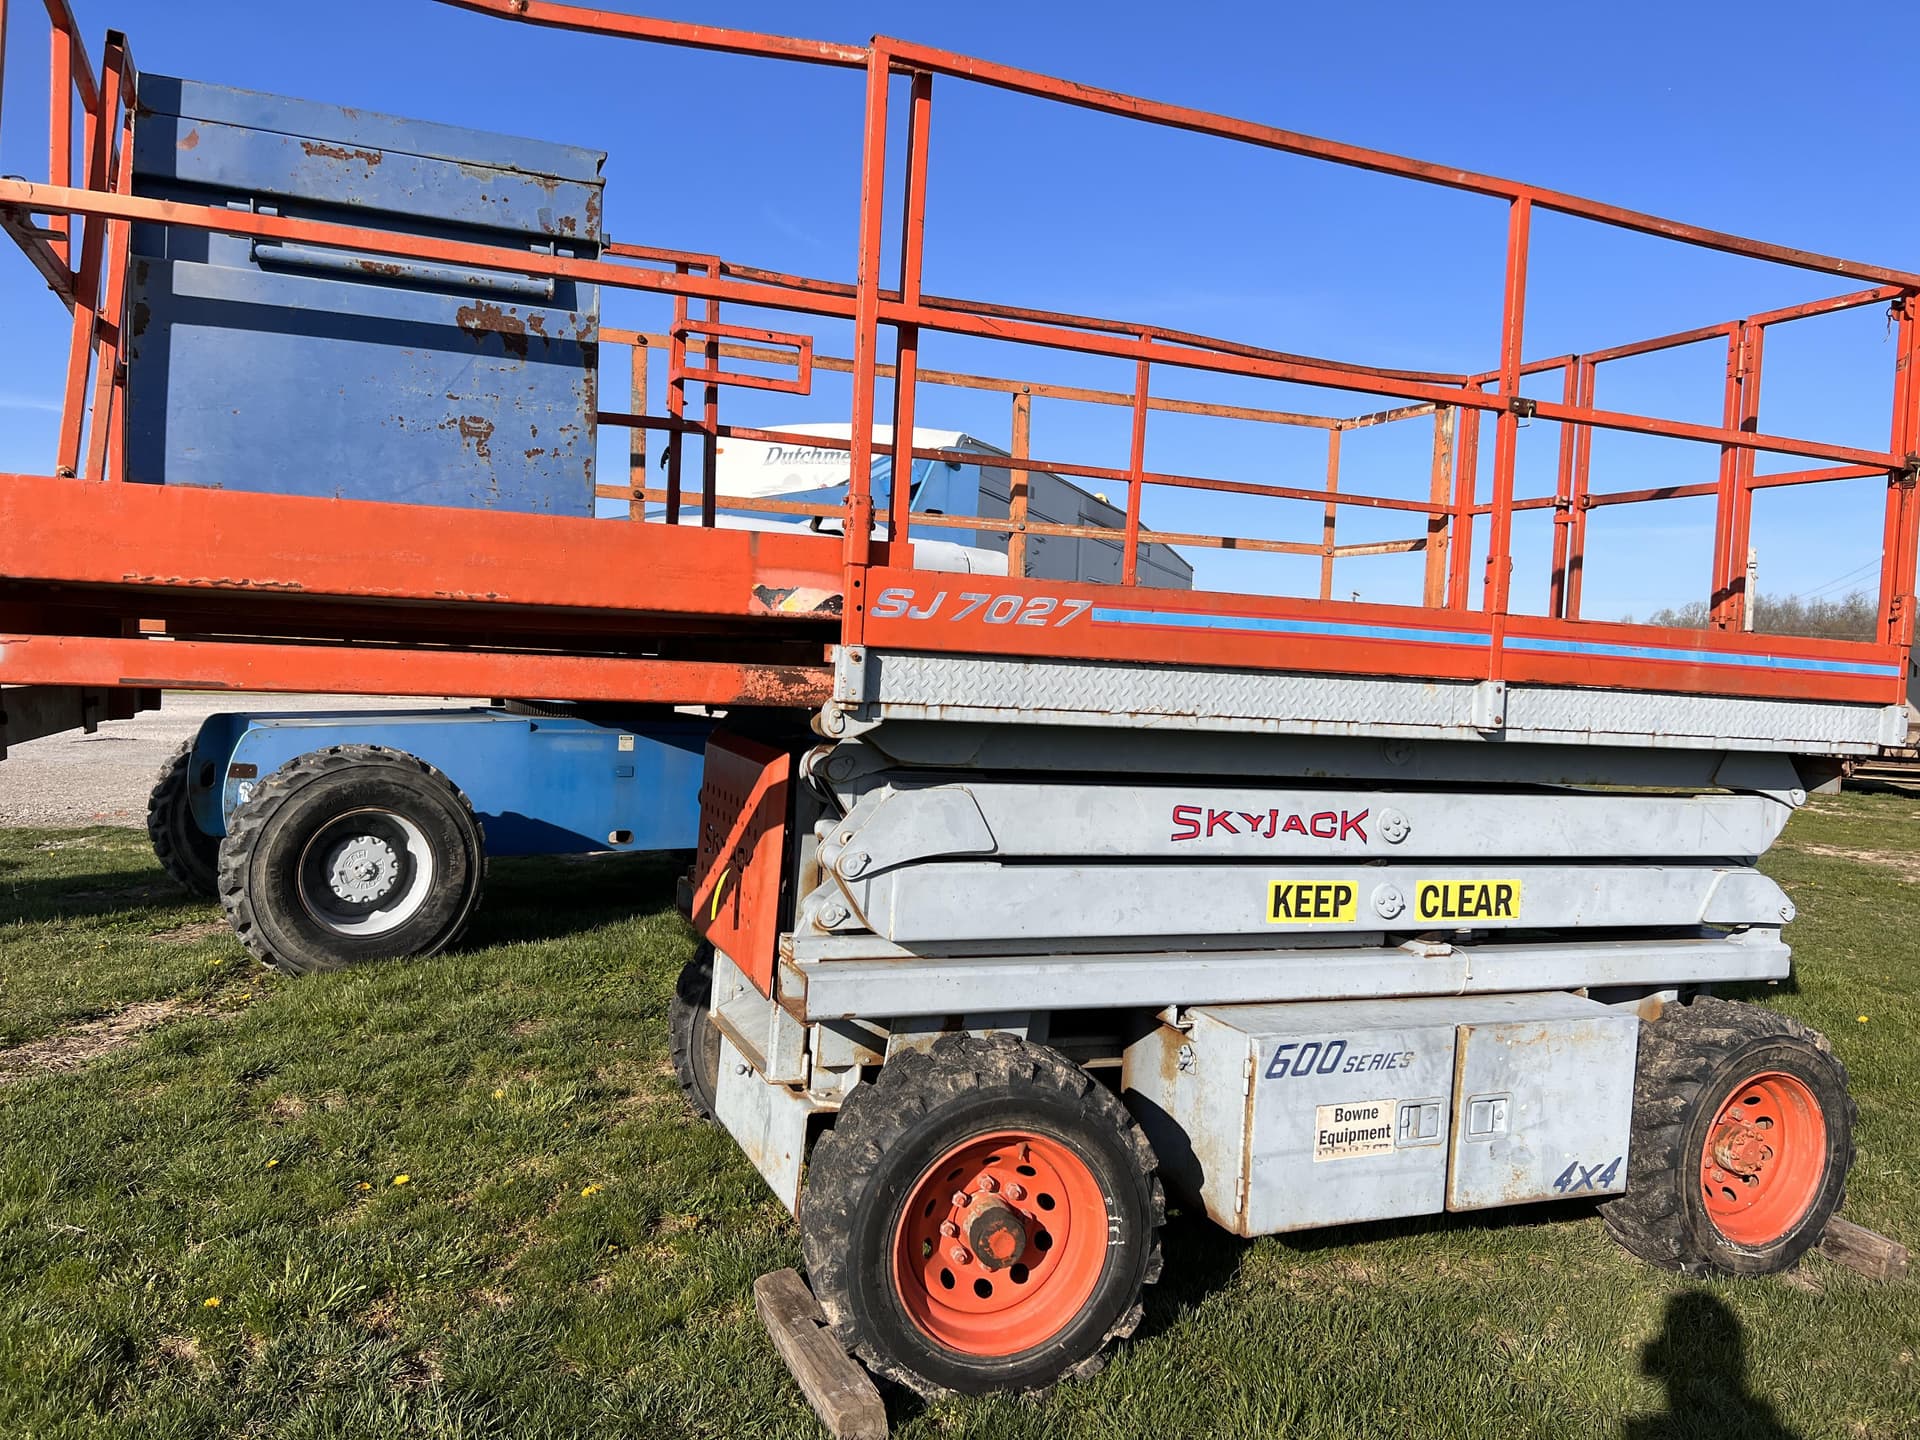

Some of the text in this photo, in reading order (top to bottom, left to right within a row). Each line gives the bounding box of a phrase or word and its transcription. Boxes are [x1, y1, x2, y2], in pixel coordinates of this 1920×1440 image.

[763, 446, 851, 466] Dutchme
[869, 587, 1094, 627] SJ 7027
[1170, 804, 1369, 844] SKYJACK
[1272, 884, 1513, 918] KEEP CLEAR
[1264, 1039, 1415, 1080] 600 SERIES
[1334, 1107, 1379, 1123] Bowne
[1319, 1123, 1391, 1147] Equipment
